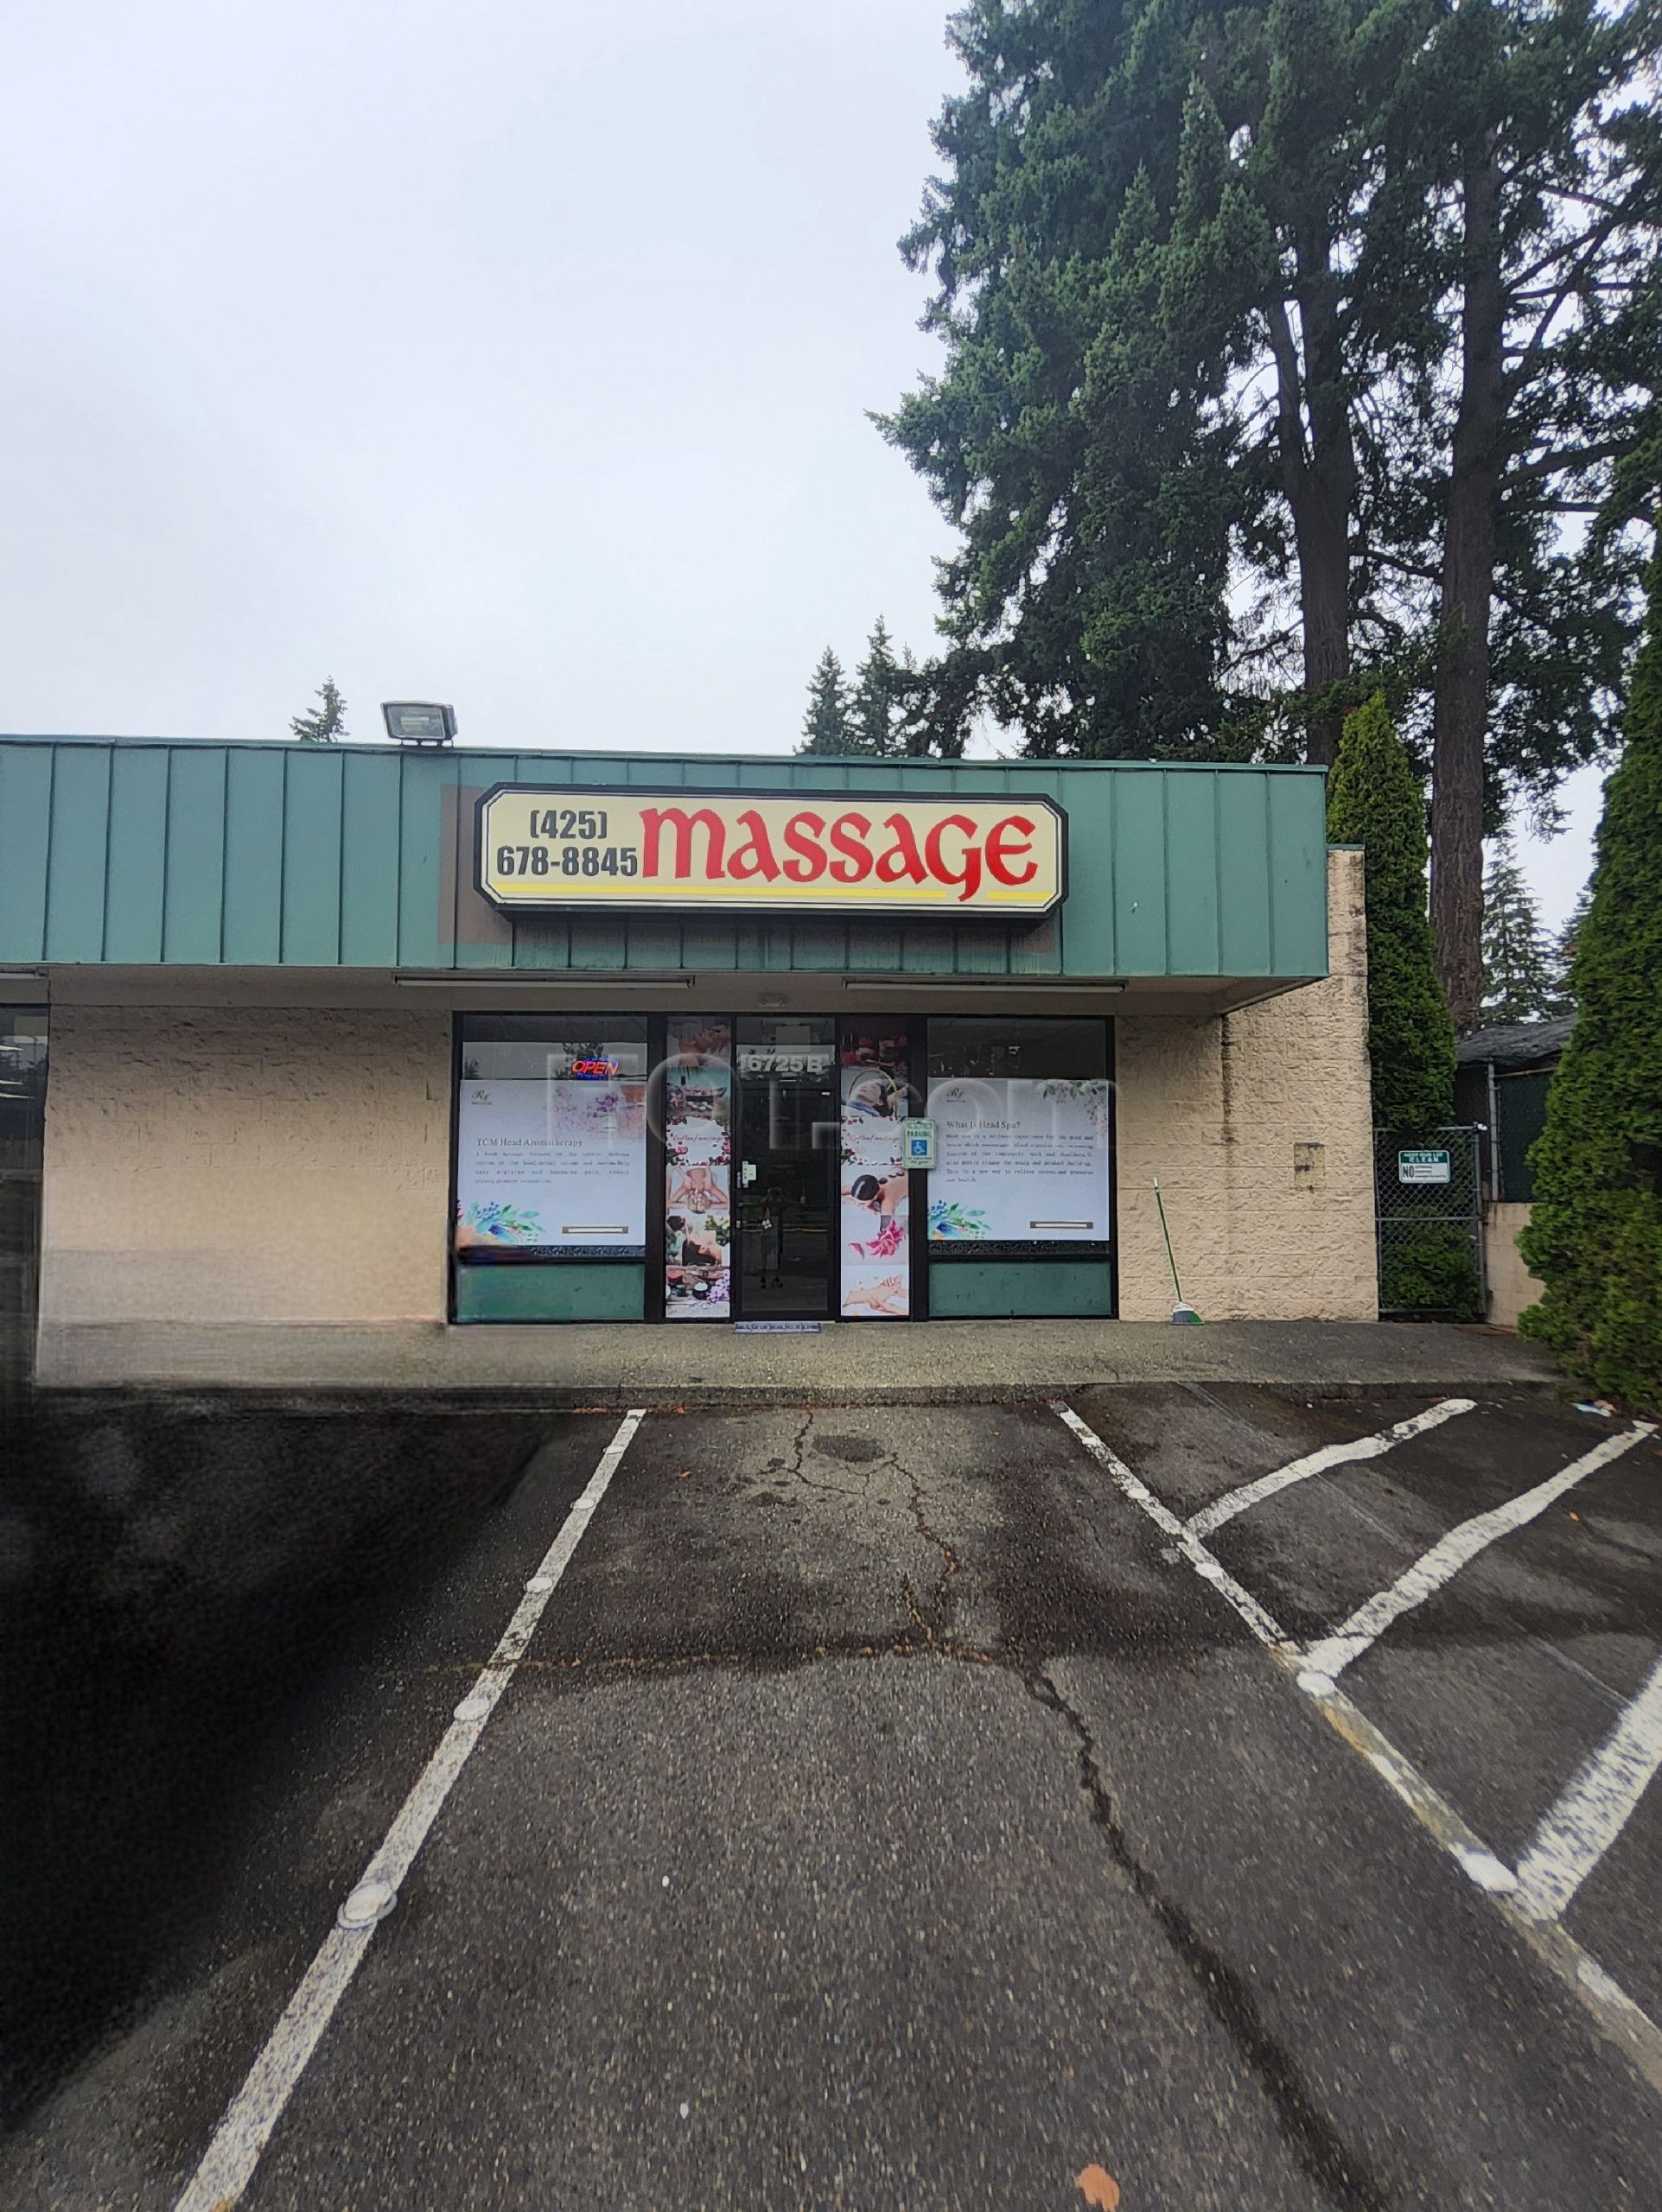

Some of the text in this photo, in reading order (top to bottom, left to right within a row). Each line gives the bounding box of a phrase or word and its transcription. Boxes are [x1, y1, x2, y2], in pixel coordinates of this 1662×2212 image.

[530, 810, 607, 839] (425)
[496, 846, 638, 877] 678-8845
[571, 1059, 620, 1077] OPEN
[946, 1120, 967, 1128] What
[979, 1120, 1000, 1128] Head
[1001, 1120, 1021, 1131] Spa?
[476, 1137, 498, 1147] TCM
[500, 1137, 522, 1147] Head
[1403, 1165, 1415, 1179] NO
